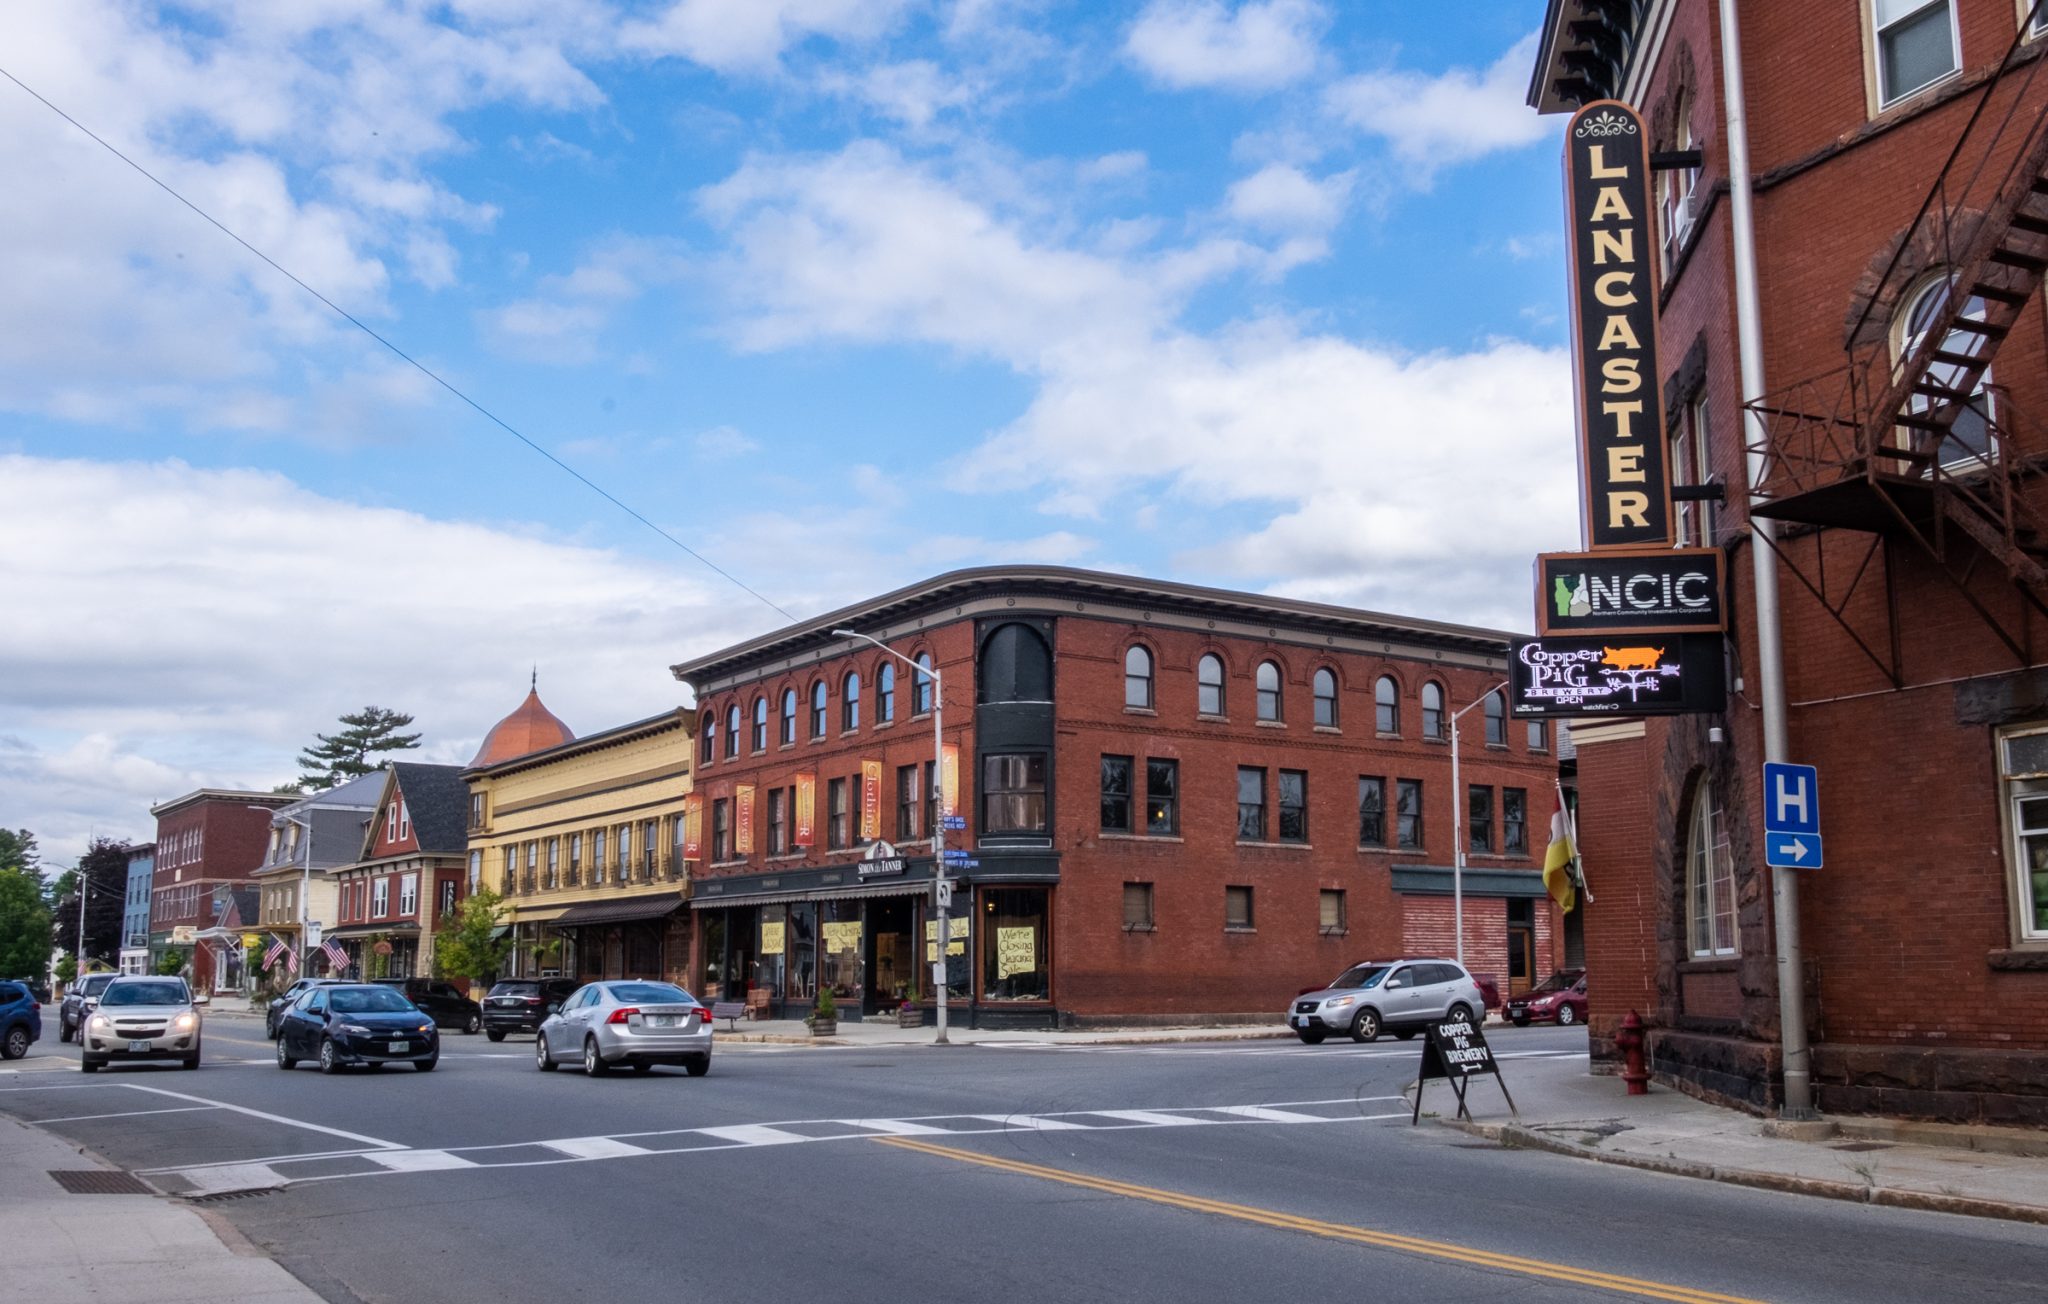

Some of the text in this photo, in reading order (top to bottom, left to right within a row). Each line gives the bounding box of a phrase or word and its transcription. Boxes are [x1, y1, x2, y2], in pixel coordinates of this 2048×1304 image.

[1588, 144, 1650, 528] LANCASTER
[1591, 572, 1710, 609] NCIC
[1617, 608, 1647, 616] Community
[1519, 642, 1602, 668] Copper
[1530, 687, 1604, 696] BREWERY
[1556, 696, 1583, 704] OPEN
[865, 763, 877, 833] Clothing
[1776, 774, 1808, 823] H
[858, 863, 875, 874] SIMON
[881, 860, 902, 872] TANNER
[1439, 1022, 1474, 1037] COPPER
[1453, 1036, 1470, 1049] PIG
[1446, 1047, 1488, 1063] BREWERY
